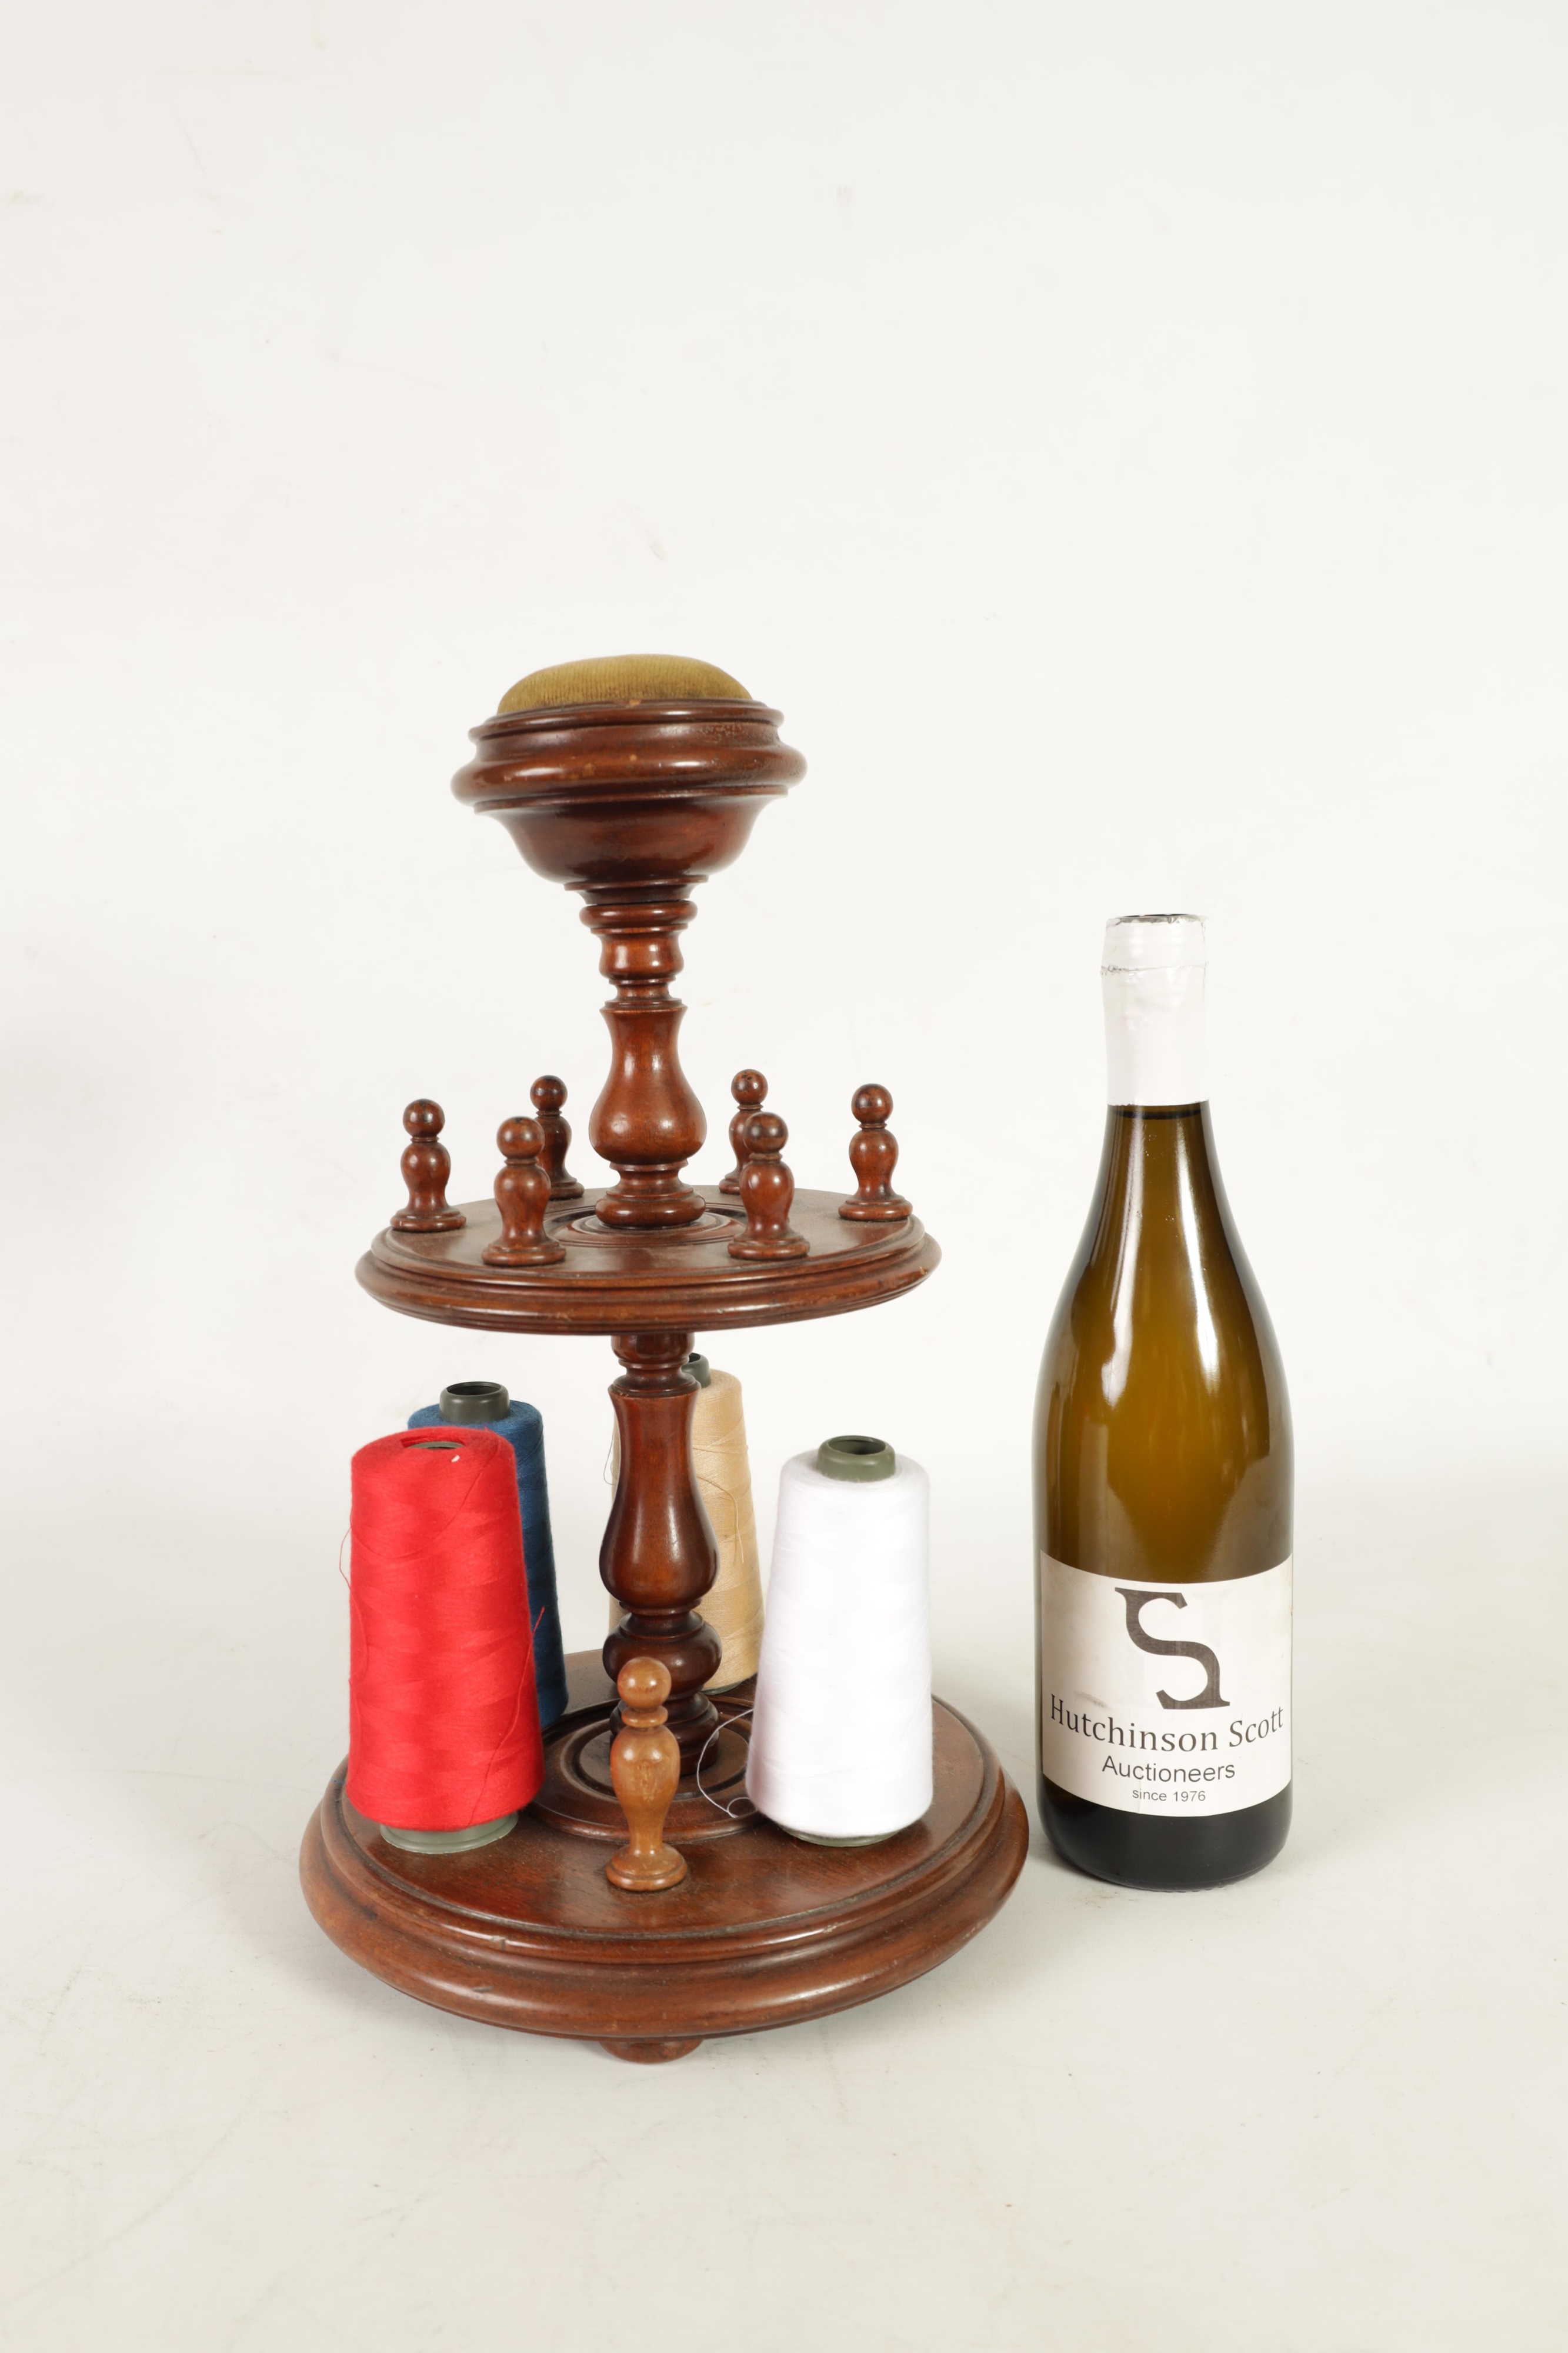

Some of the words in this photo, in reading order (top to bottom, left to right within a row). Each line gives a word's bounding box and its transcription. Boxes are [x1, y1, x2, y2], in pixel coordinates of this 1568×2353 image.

[1050, 1694, 1218, 1752] Hutchinson
[1229, 1706, 1284, 1748] Scott
[1102, 1755, 1236, 1783] Auctioneers
[1132, 1789, 1167, 1802] since
[1173, 1790, 1206, 1802] 1976
